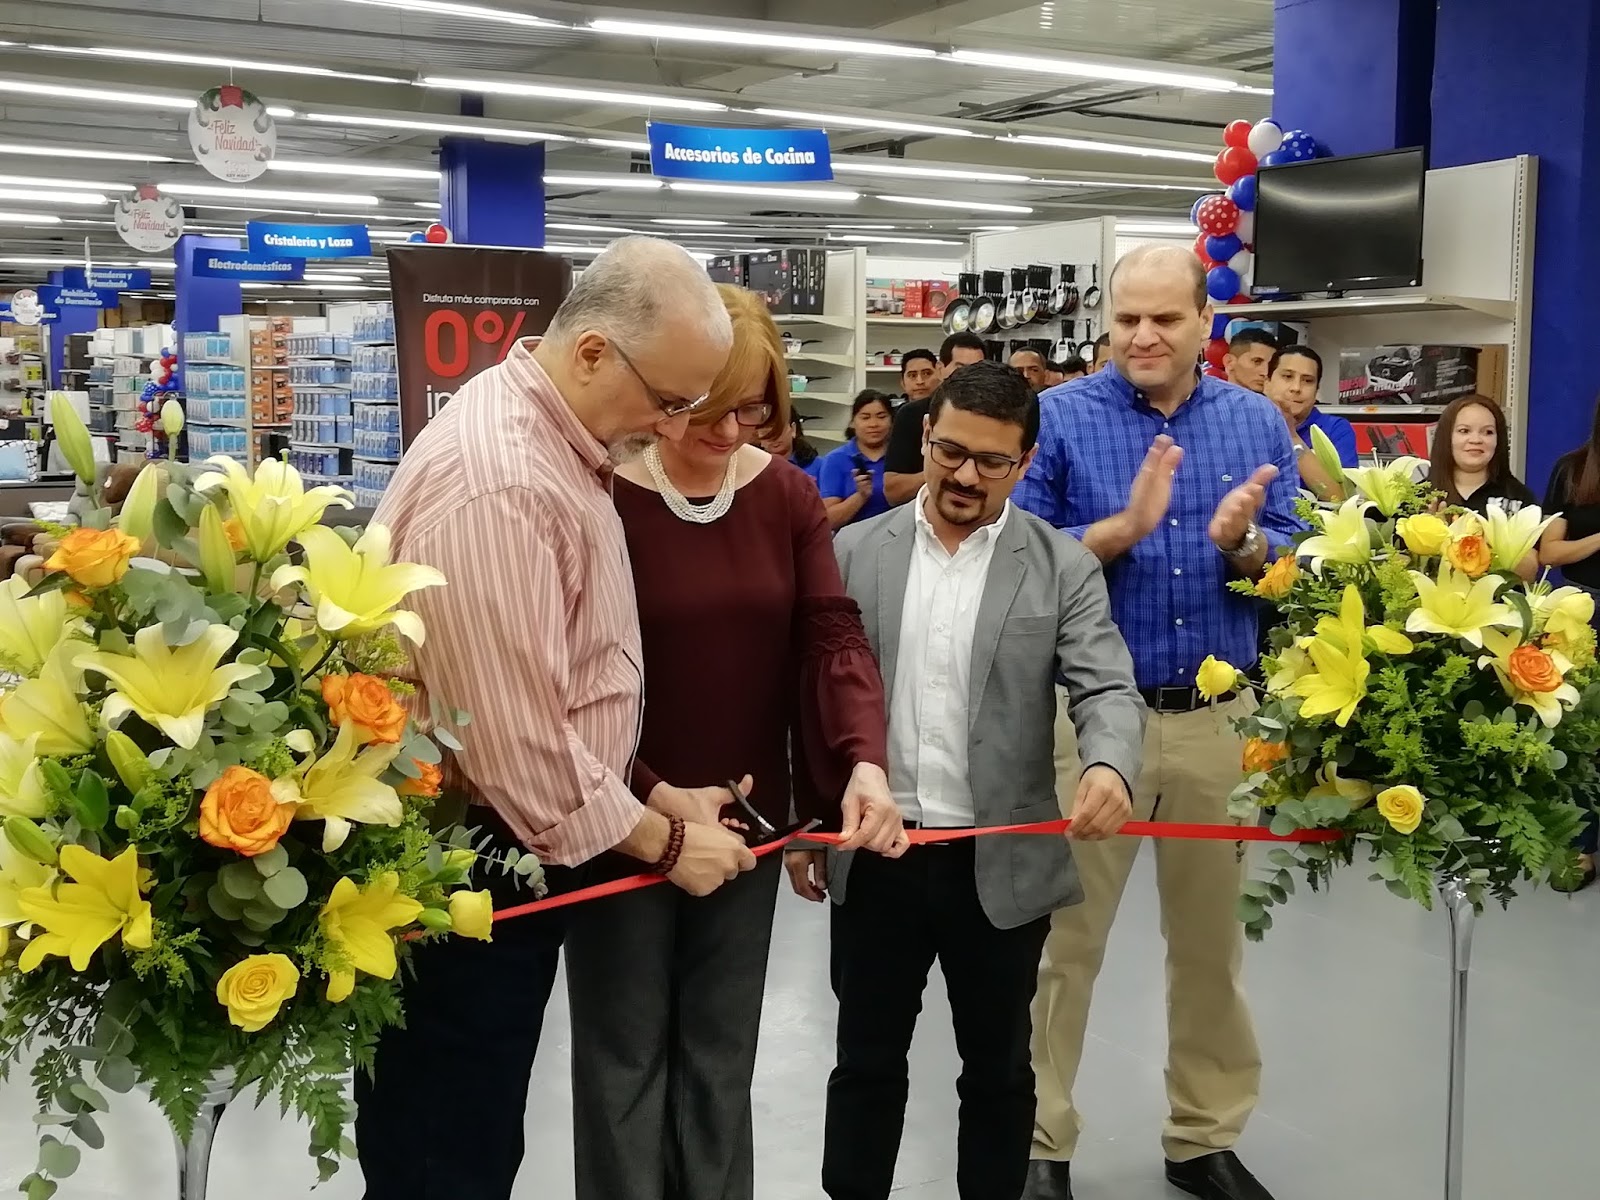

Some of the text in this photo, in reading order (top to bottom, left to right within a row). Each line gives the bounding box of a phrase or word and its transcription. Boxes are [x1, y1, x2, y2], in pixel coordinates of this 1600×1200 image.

[213, 120, 236, 134] Feliz
[214, 135, 257, 152] Navidad
[664, 142, 815, 165] Accesorios de Cocina
[133, 220, 166, 232] Navidad
[319, 238, 328, 249] y
[327, 237, 354, 248] Loza
[208, 258, 292, 272] Electrodomésticos
[423, 293, 540, 306] Disfruta más comprando con
[424, 309, 526, 379] 0%
